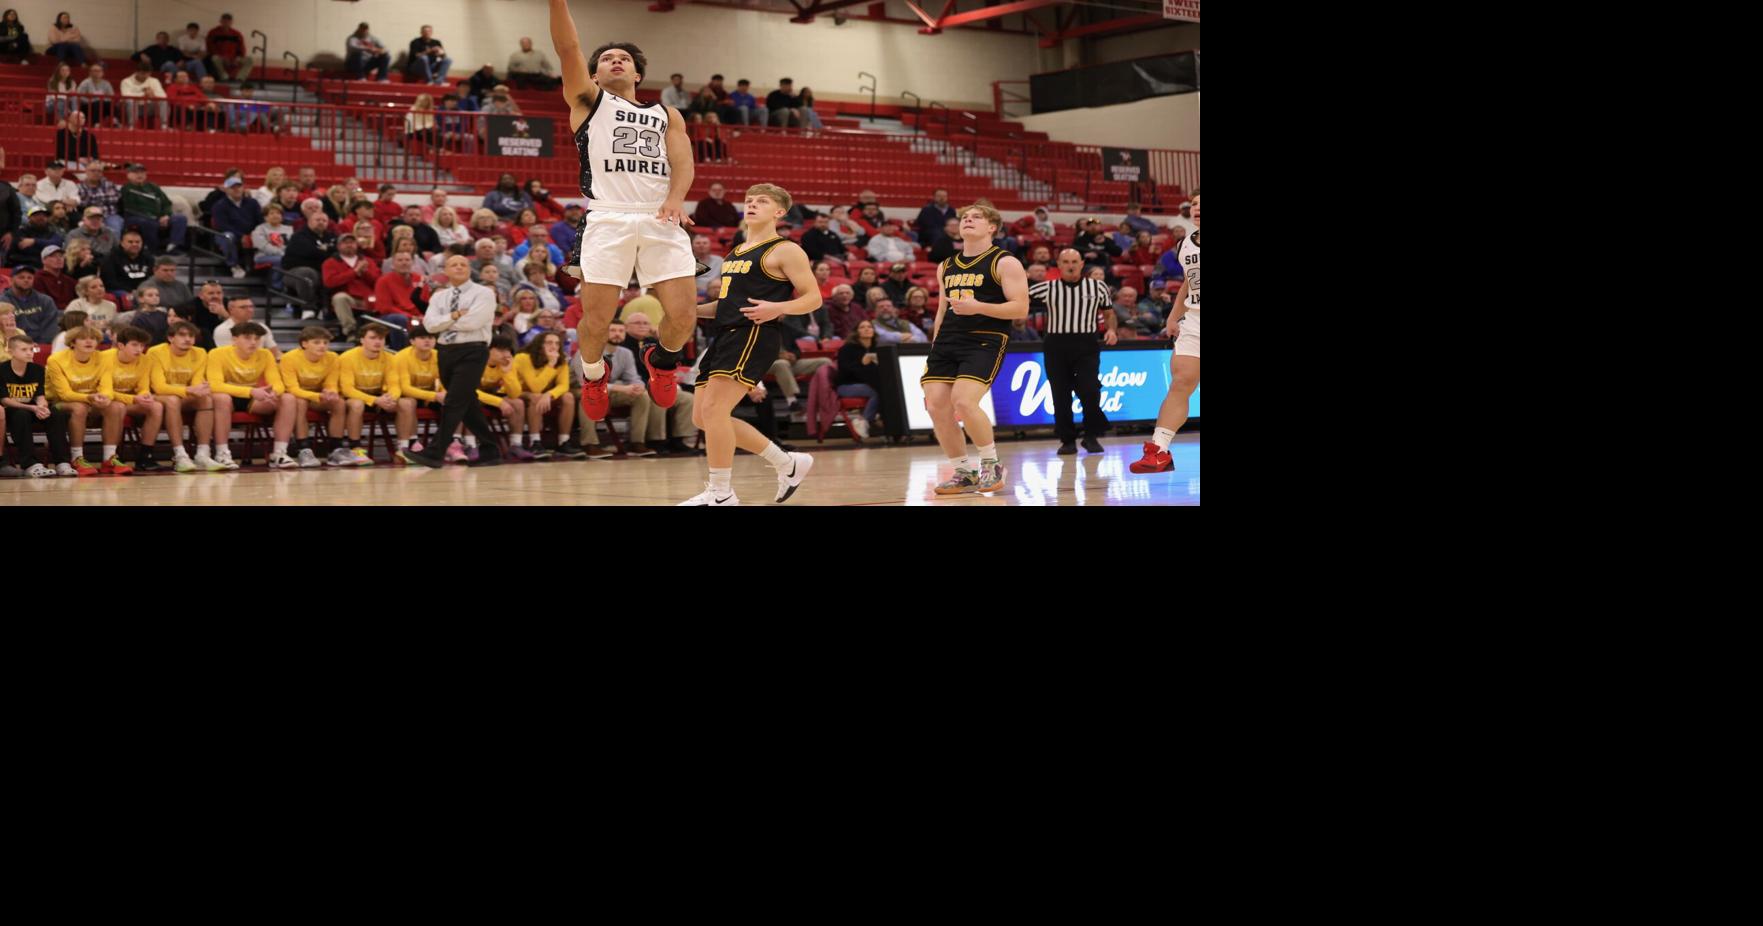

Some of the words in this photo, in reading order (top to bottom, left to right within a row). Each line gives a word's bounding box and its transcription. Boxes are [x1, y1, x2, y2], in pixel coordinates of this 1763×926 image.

[1165, 6, 1200, 18] SIXTEE
[615, 109, 667, 134] SOUTH
[498, 137, 542, 148] RESERVED
[612, 126, 660, 158] 23
[501, 146, 539, 157] SEATING
[604, 159, 667, 176] LAUREL
[1185, 253, 1200, 265] SO
[945, 273, 984, 288] TIGERS
[1011, 361, 1147, 417] Wdow
